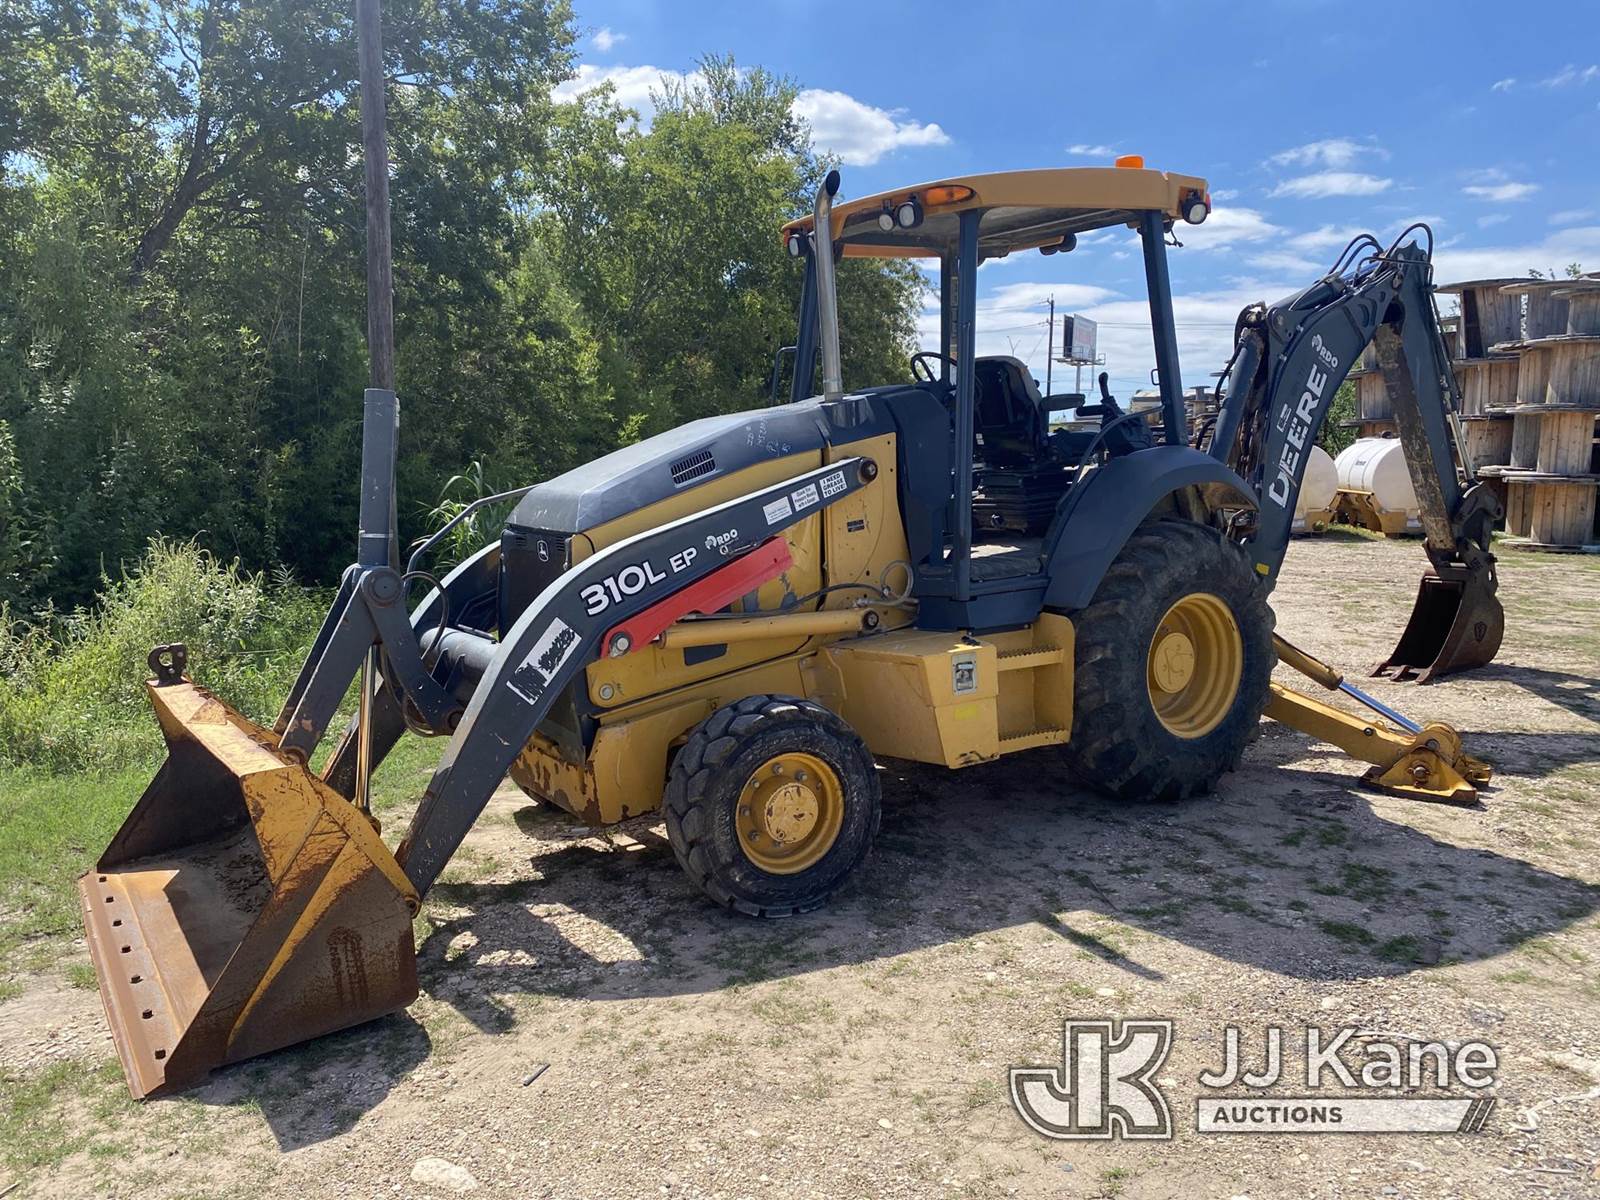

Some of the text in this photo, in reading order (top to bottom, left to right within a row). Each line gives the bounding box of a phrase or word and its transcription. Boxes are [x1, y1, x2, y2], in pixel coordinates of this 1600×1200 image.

[1320, 350, 1338, 368] RDO
[1269, 364, 1328, 508] DEERE
[823, 478, 844, 490] GREASE
[826, 473, 841, 482] NEED
[824, 489, 832, 497] TO
[716, 528, 738, 546] RDO
[581, 548, 697, 616] 310L EP
